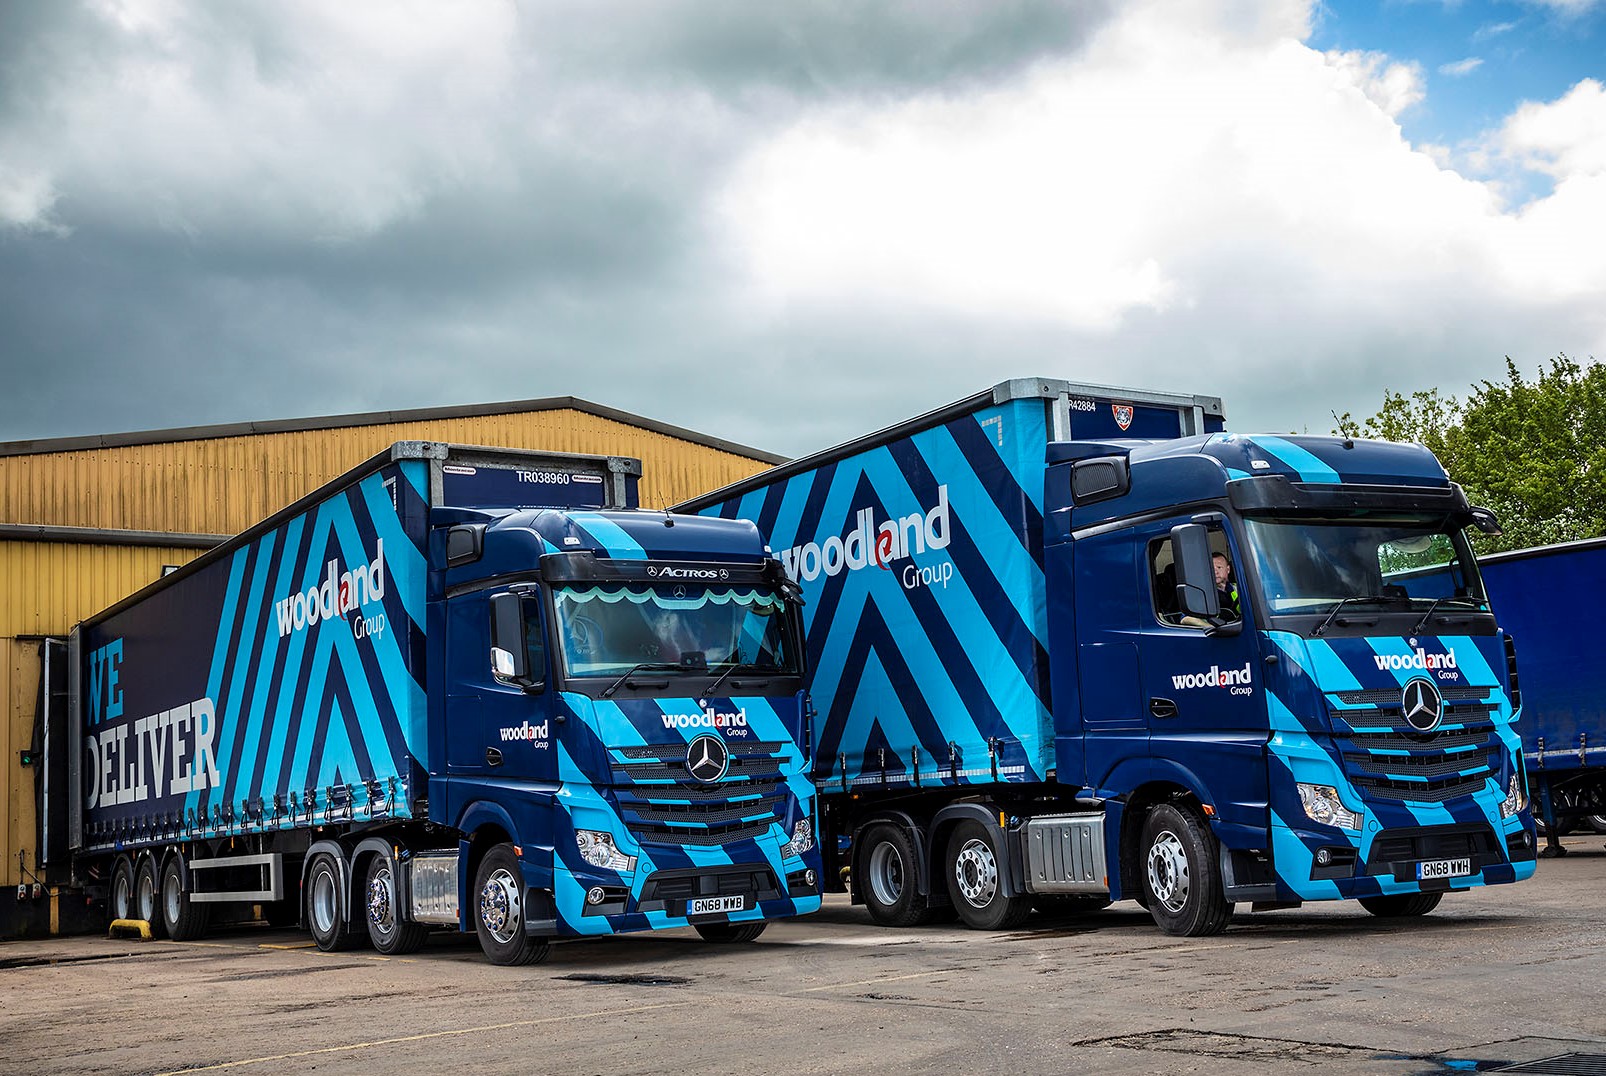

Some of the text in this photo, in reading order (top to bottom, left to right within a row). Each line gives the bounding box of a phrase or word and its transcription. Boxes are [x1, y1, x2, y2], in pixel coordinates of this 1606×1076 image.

[516, 470, 570, 485] TR038960
[903, 561, 953, 590] Group
[276, 538, 385, 638] woodland
[354, 613, 385, 640] Group
[1374, 647, 1457, 672] woodland
[85, 637, 124, 727] WE
[1171, 662, 1252, 689] woodland
[1438, 670, 1459, 682] Group
[1230, 686, 1253, 697] Group
[661, 707, 747, 730] woodland
[500, 719, 549, 742] woodland
[726, 728, 748, 738] Group
[83, 697, 220, 810] DELIVER
[534, 740, 549, 750] Group
[1423, 860, 1469, 876] GN68 WWH
[694, 897, 742, 912] GN68 WWB
